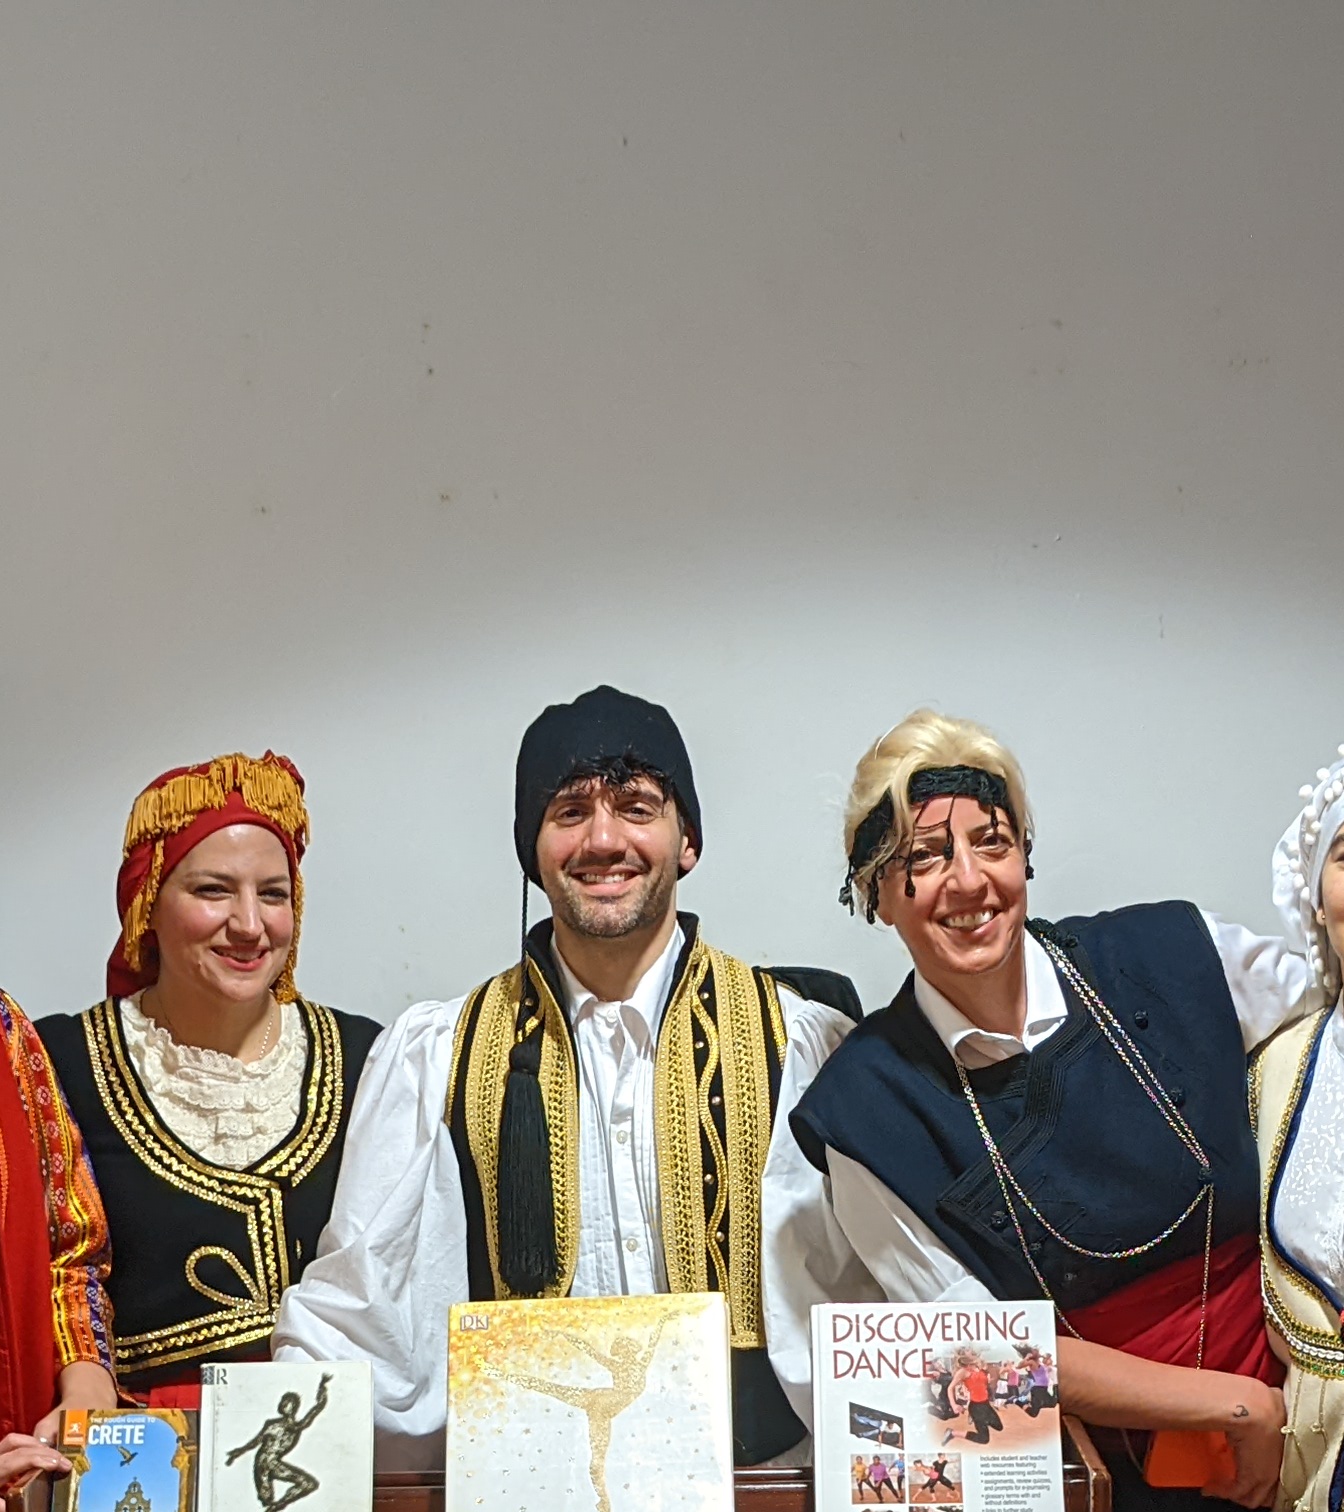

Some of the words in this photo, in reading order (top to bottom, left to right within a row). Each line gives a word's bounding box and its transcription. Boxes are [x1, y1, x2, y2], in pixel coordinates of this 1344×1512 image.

[463, 1315, 485, 1329] DK
[832, 1311, 1030, 1343] DISCOVERING
[833, 1348, 935, 1379] DANCE
[88, 1425, 146, 1445] CRETE
